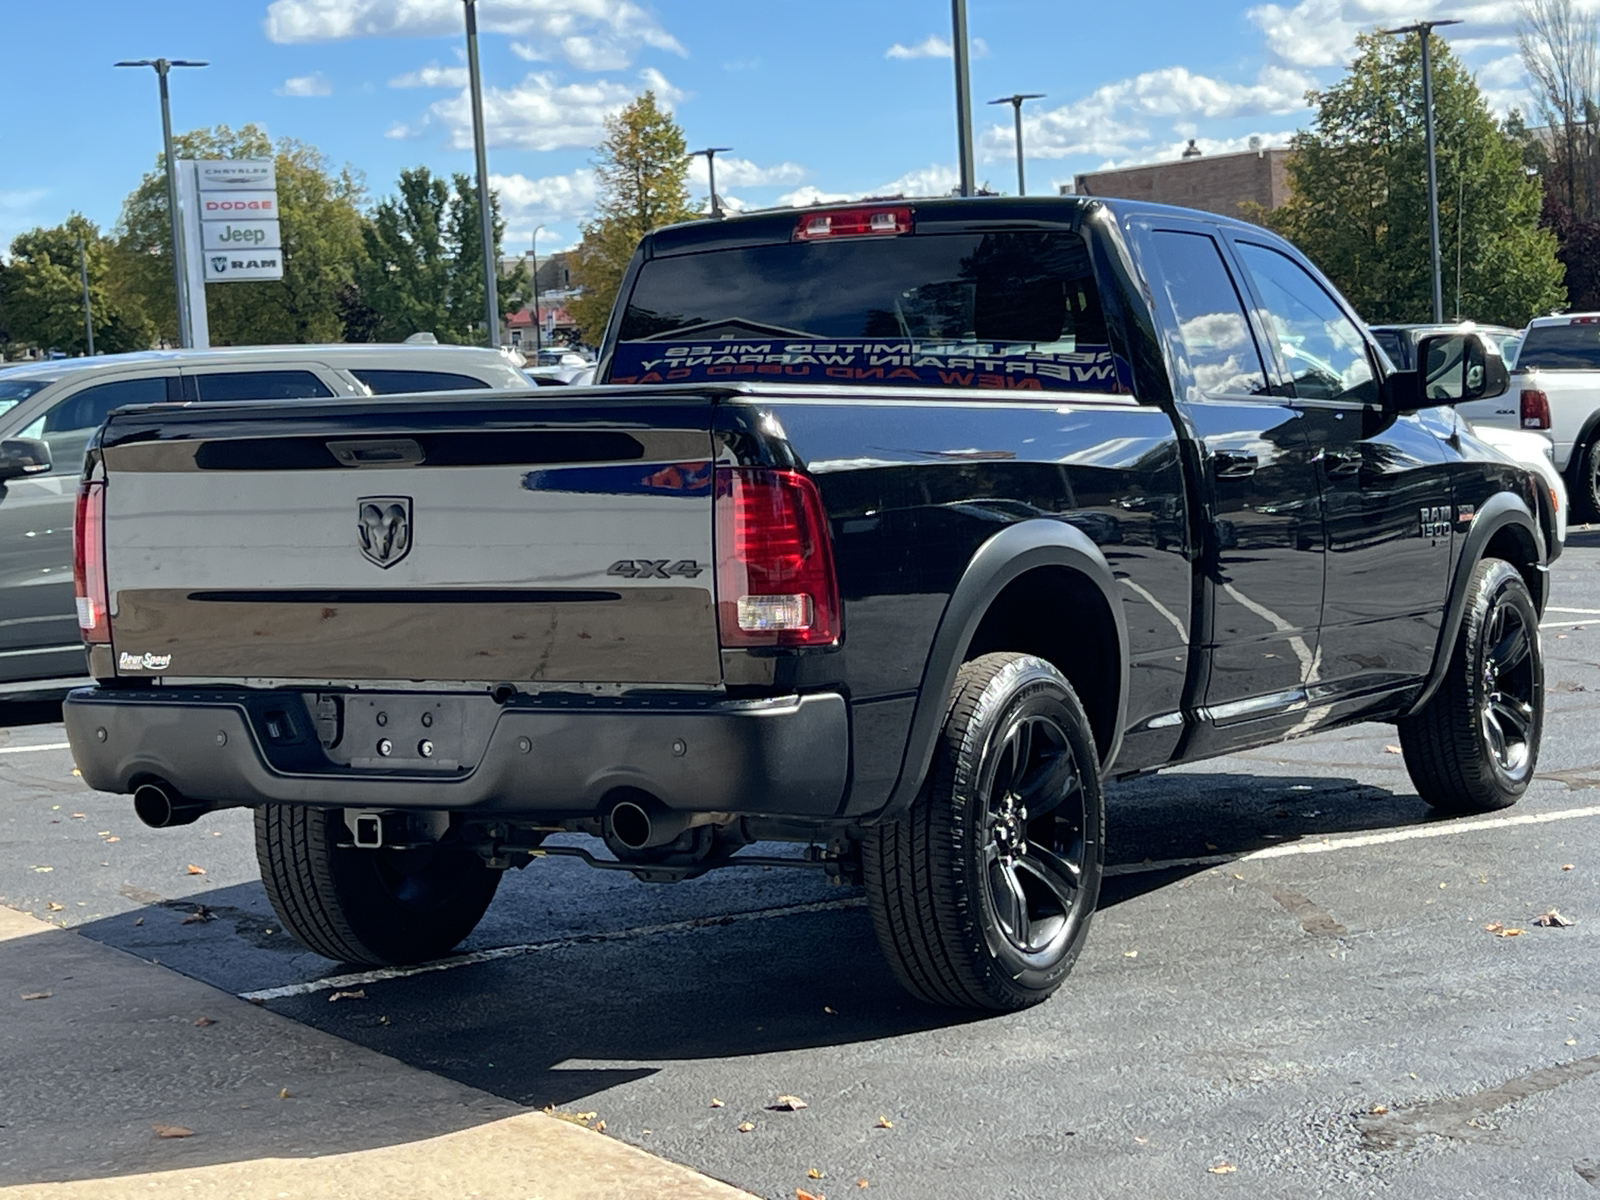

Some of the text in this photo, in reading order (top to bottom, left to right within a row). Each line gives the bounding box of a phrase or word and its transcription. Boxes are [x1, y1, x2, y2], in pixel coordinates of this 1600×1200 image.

[206, 201, 272, 210] DODGE
[219, 225, 265, 245] Jeep
[231, 260, 277, 269] RAM
[1420, 505, 1452, 522] RAM
[1421, 521, 1452, 538] 1500
[606, 560, 703, 579] 4X4
